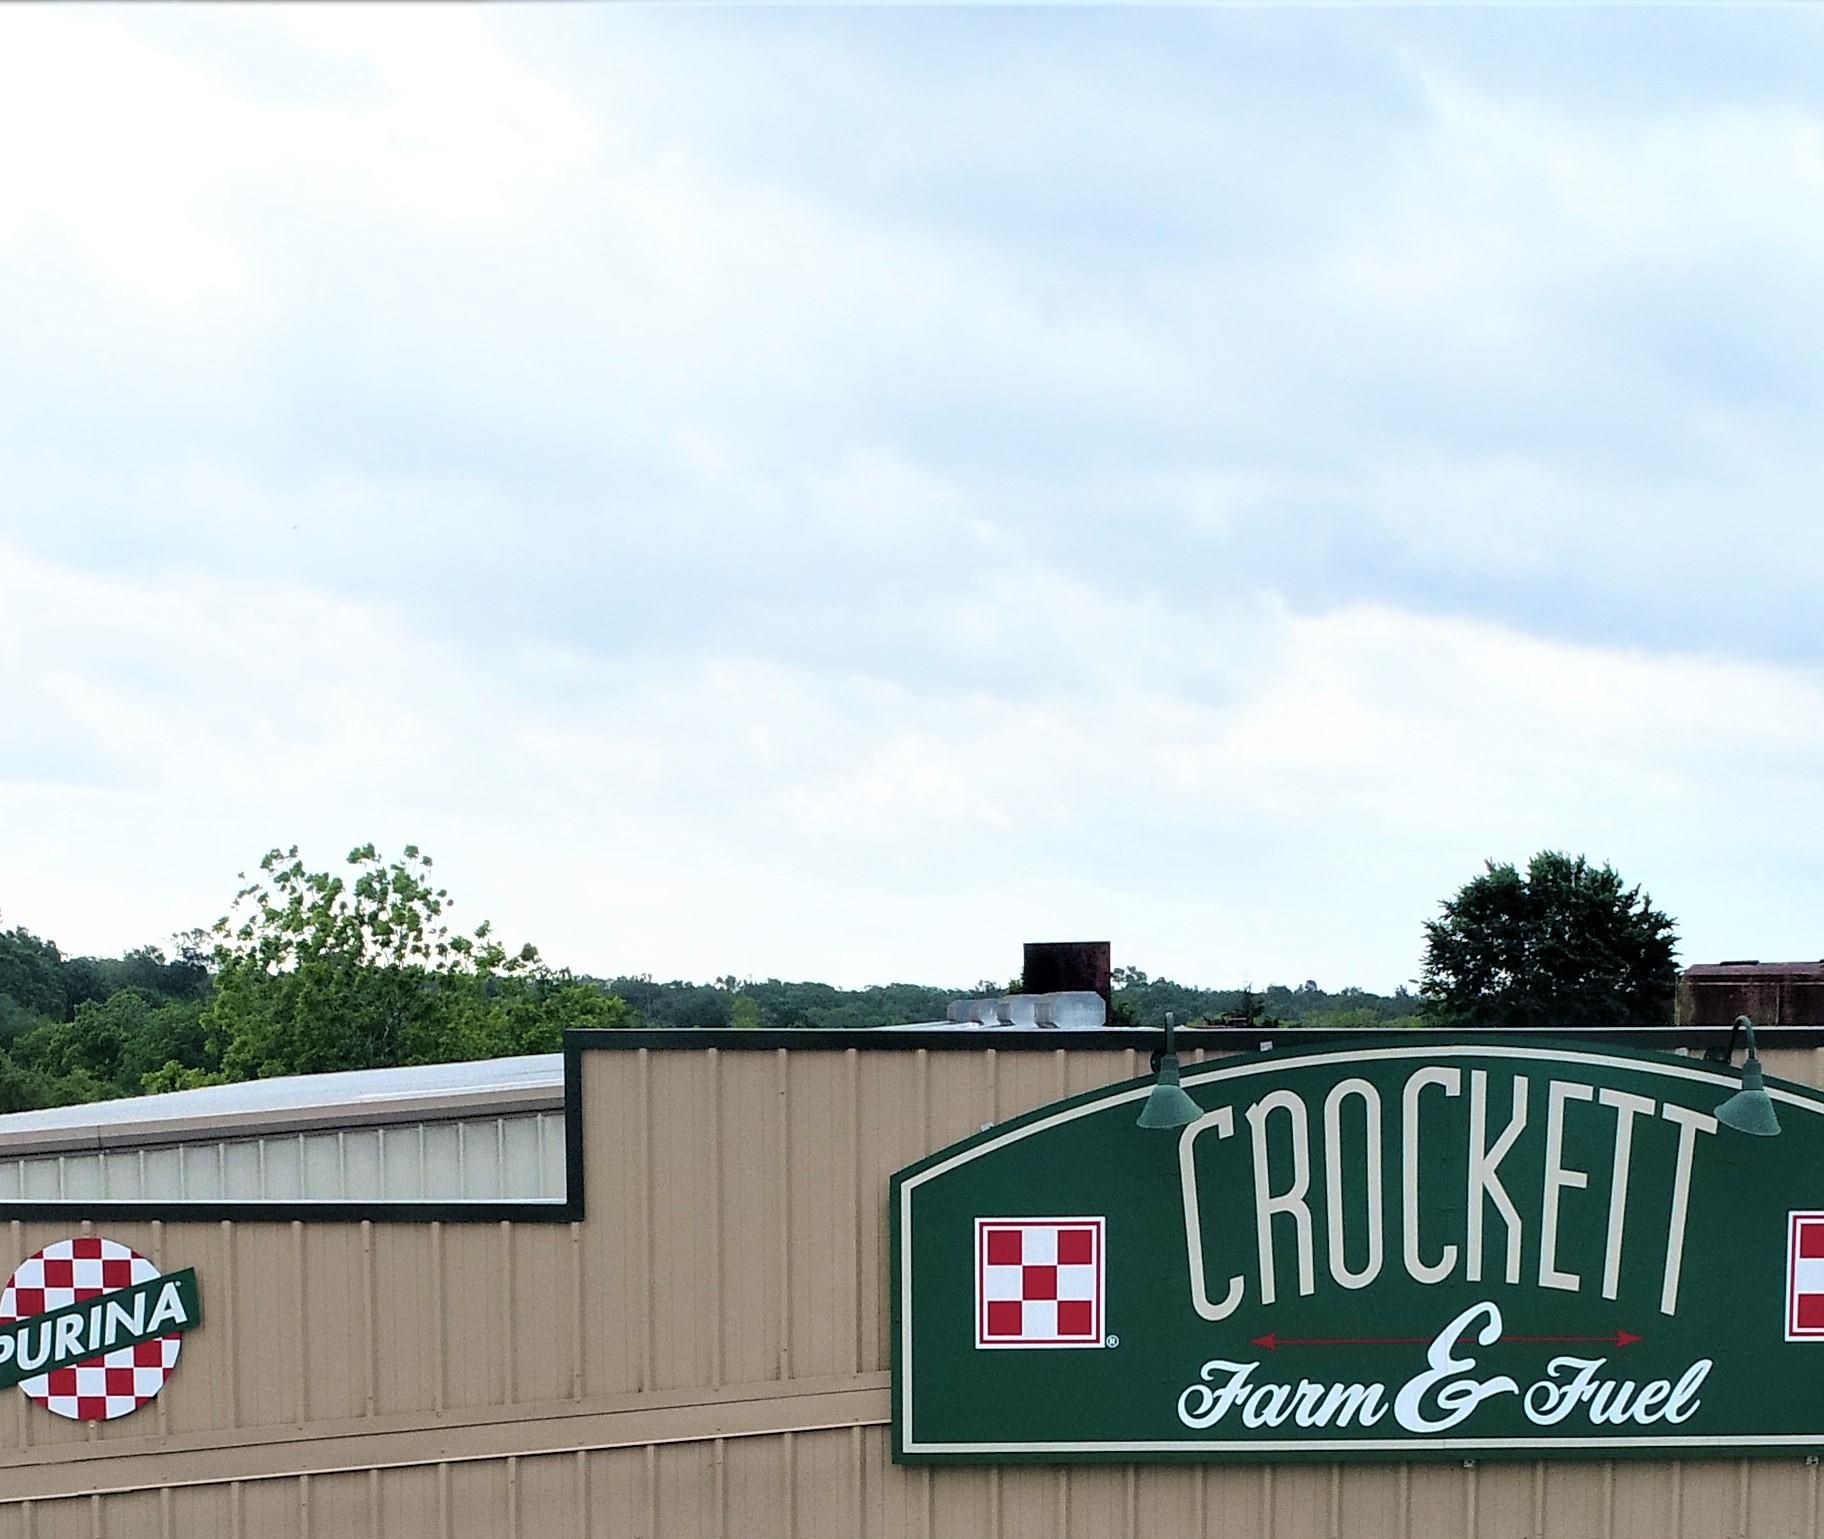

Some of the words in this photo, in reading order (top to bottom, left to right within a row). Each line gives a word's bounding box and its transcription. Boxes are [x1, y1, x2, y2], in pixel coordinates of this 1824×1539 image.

[1177, 1066, 1718, 1321] CROCKETT
[1177, 1358, 1390, 1431] Farm
[1394, 1301, 1519, 1434] &
[1522, 1357, 1715, 1427] Fuel
